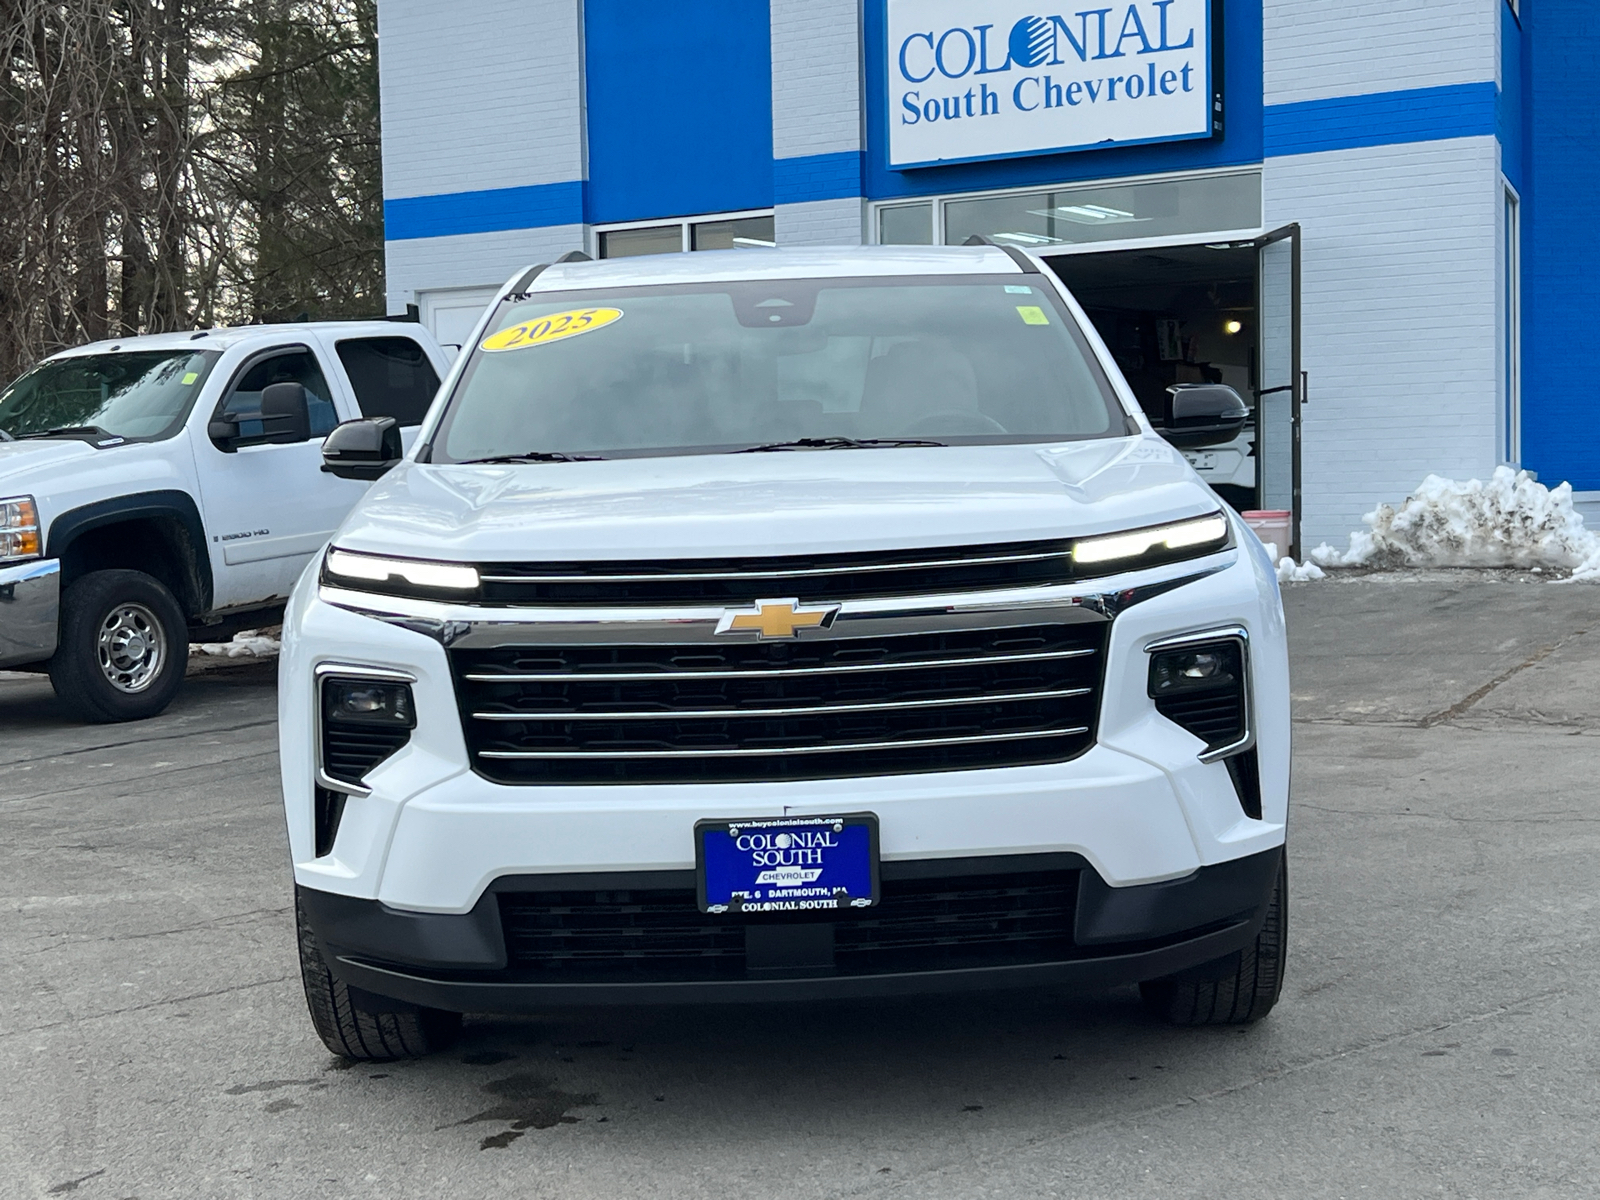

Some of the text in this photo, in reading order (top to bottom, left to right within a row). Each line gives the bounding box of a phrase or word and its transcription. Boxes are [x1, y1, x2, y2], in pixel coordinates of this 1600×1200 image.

[899, 0, 1194, 83] COLONIAL
[901, 60, 1195, 126] South Chevrolet
[504, 310, 598, 347] 2025
[729, 818, 843, 828] www.buycolonialsouth.com
[736, 831, 838, 851] COLONIAL
[752, 849, 823, 867] SOUTH
[762, 871, 816, 881] CHEVROLET
[754, 890, 762, 899] 6
[768, 887, 831, 898] DARTMOUTH,
[742, 899, 838, 912] COLONIAL SOUTH
